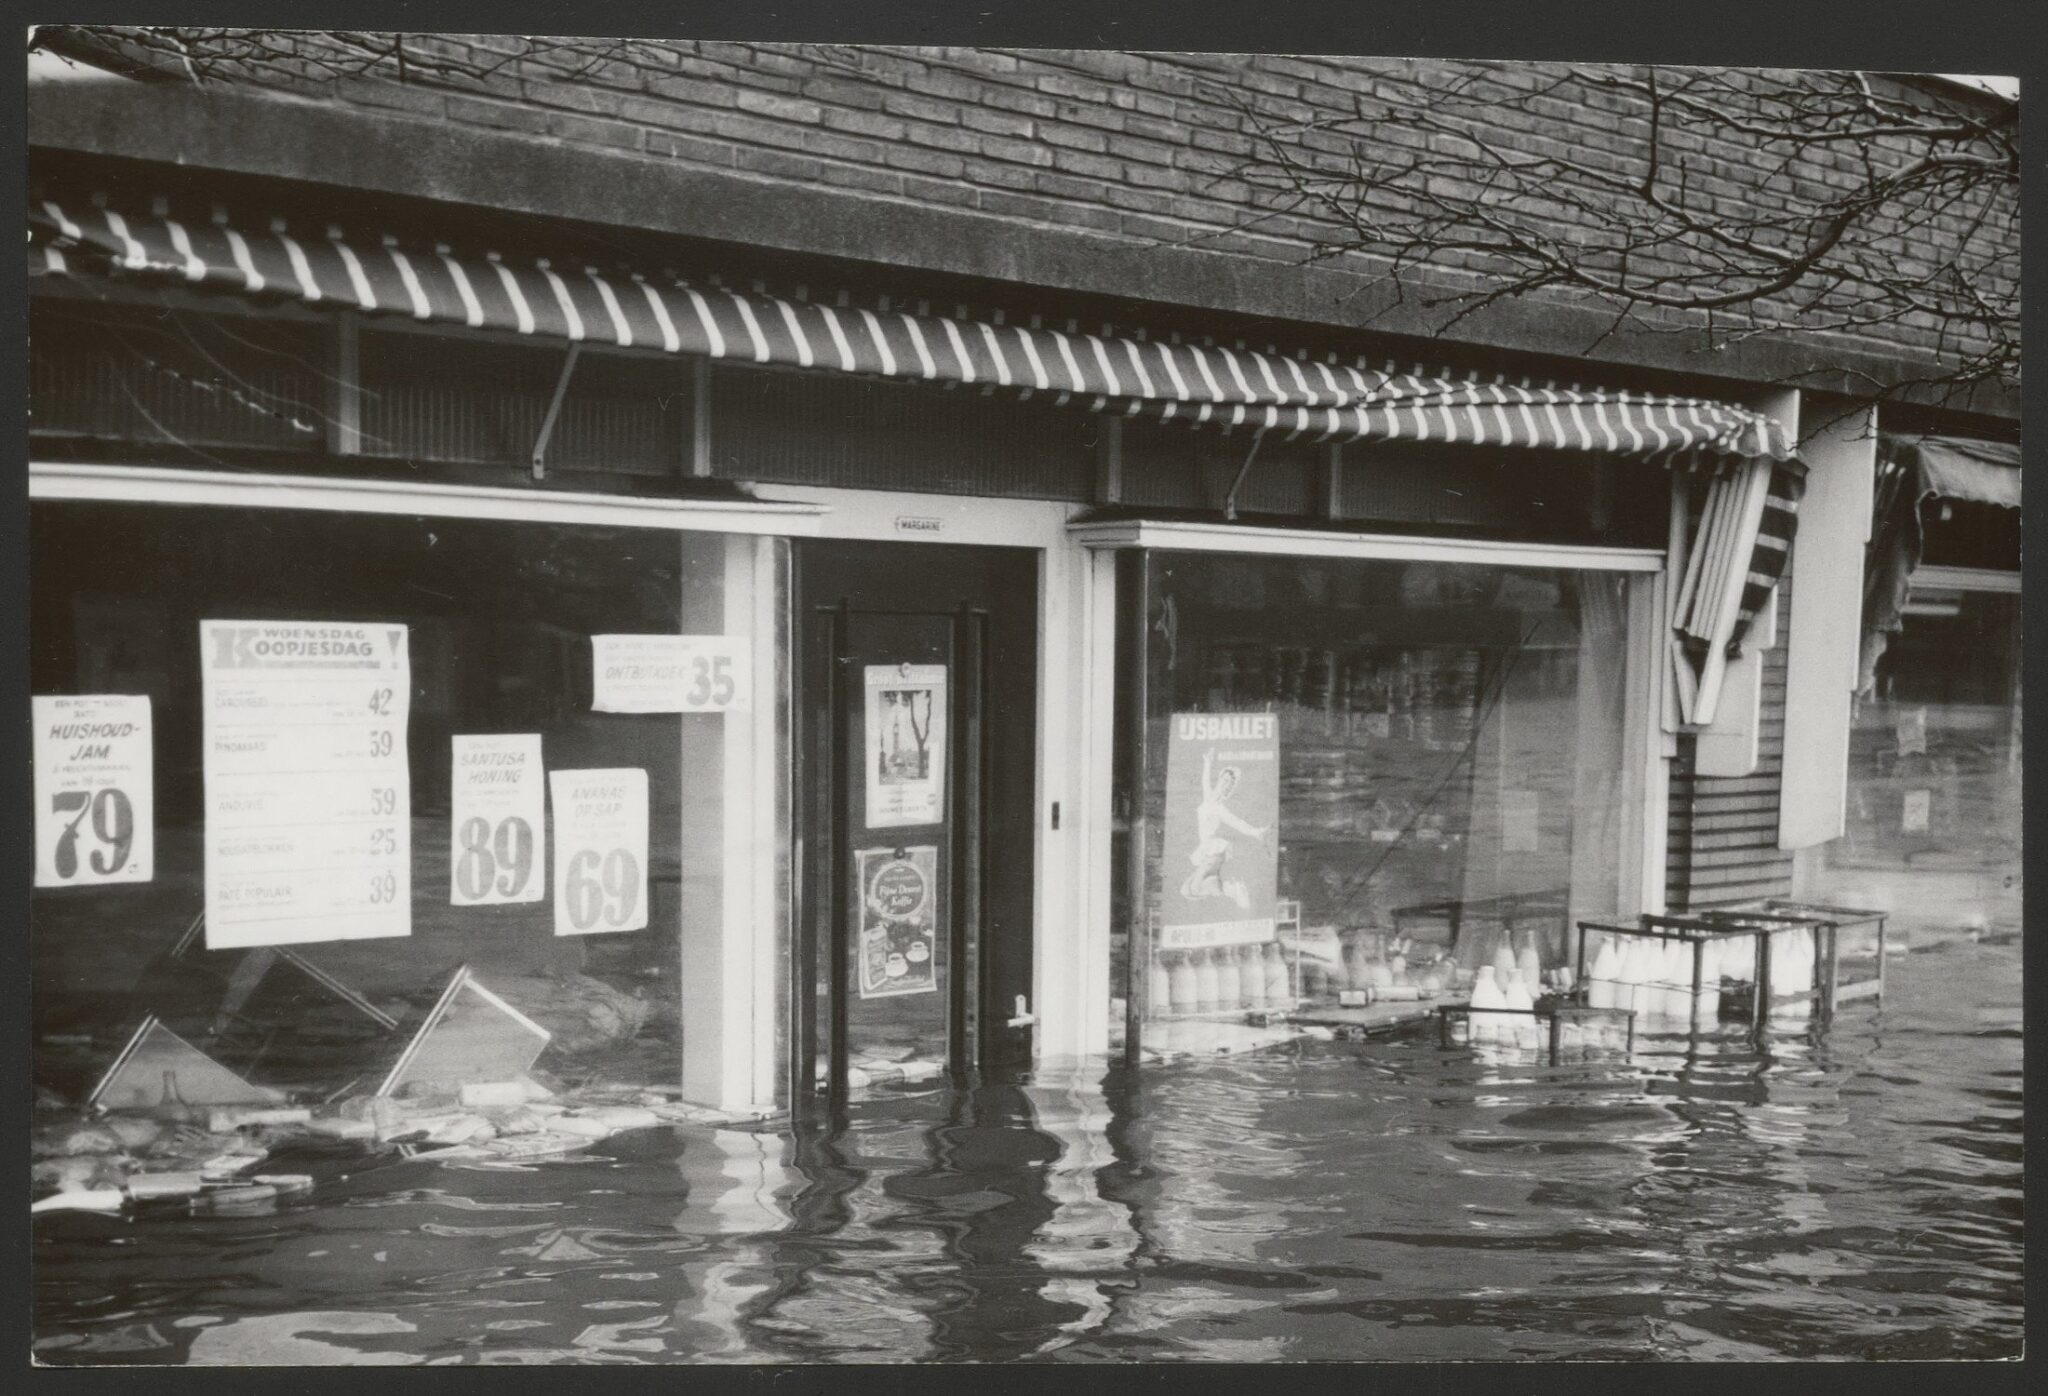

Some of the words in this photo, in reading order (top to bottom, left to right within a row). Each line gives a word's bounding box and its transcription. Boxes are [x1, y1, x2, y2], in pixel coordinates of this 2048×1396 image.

[263, 628, 366, 640] WOENSDAG
[686, 655, 735, 706] 35
[368, 687, 394, 716] 42
[49, 722, 141, 740] HUISHOUD-
[369, 730, 394, 758] 59
[69, 744, 111, 761] JAM
[460, 752, 526, 767] SANTUSA
[467, 769, 523, 784] HONING
[370, 788, 396, 816] 59
[571, 785, 628, 800] ANANAS
[593, 802, 623, 817] SAP
[52, 788, 134, 880] 79
[369, 828, 397, 856] 25
[456, 816, 534, 901] 89
[368, 873, 397, 905] 39
[565, 848, 640, 930] 69
